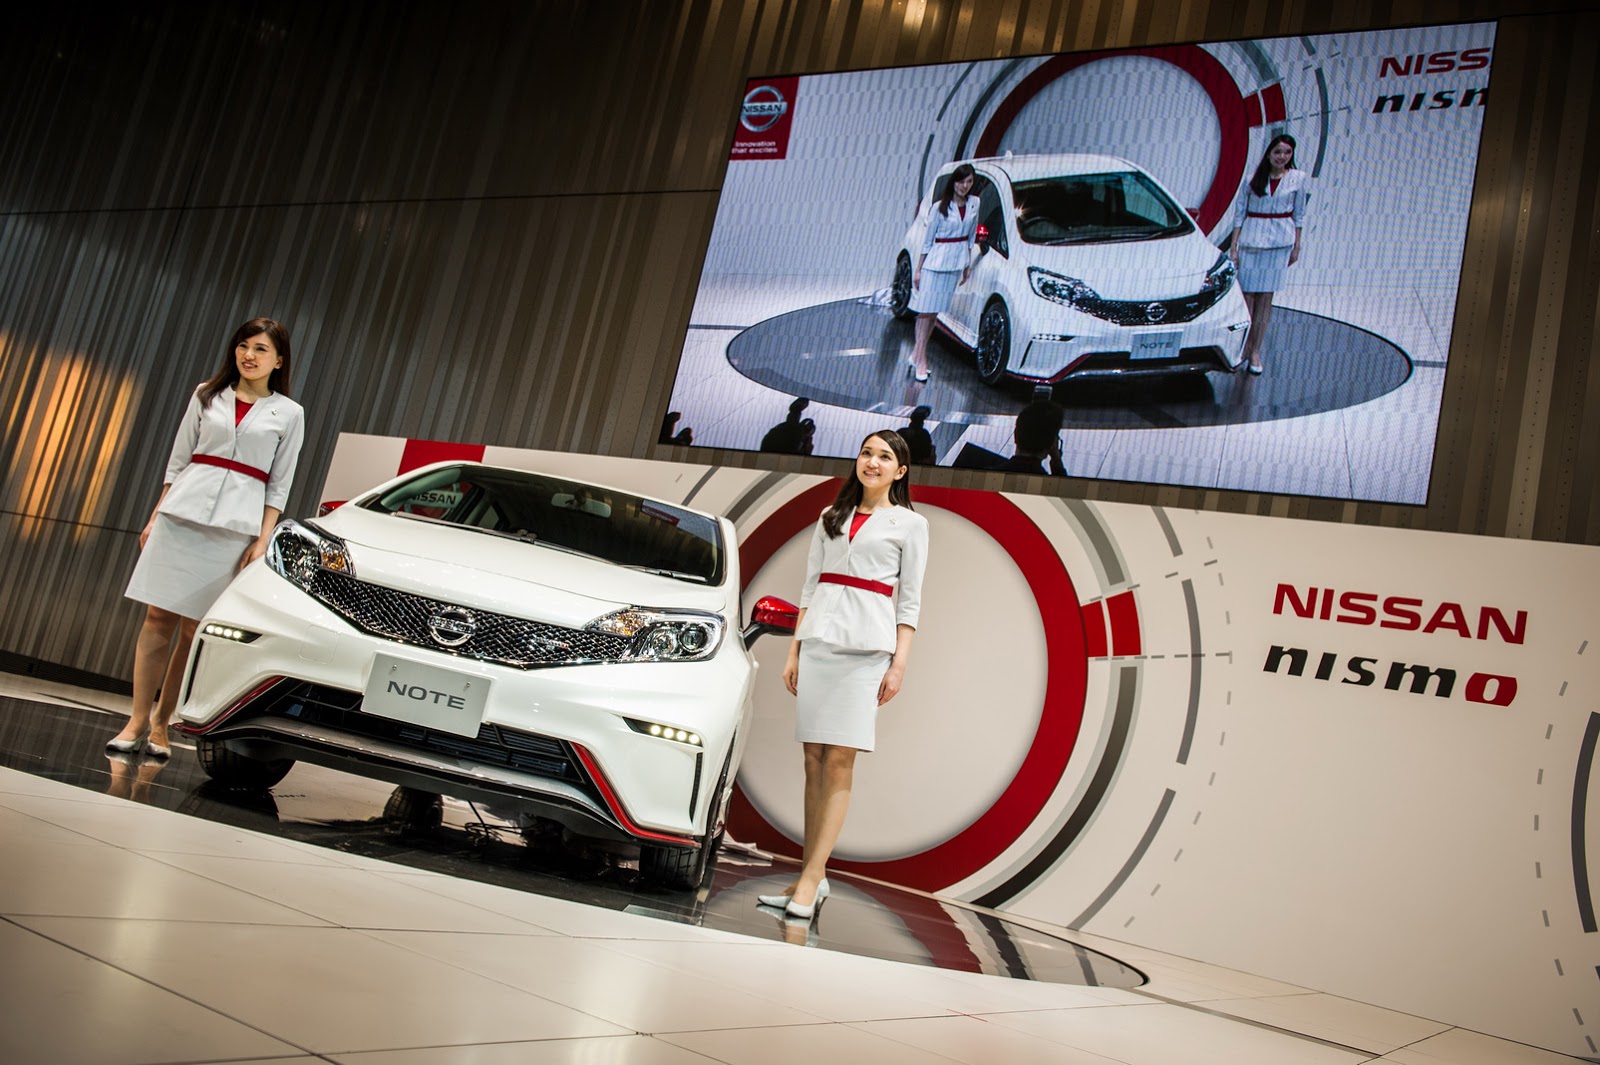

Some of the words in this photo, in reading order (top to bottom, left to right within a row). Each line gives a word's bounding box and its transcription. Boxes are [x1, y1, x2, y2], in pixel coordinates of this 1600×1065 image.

[1379, 47, 1491, 78] NISS
[741, 104, 782, 113] NISSAN
[1140, 341, 1174, 350] NOTE
[1272, 583, 1528, 645] NISSAN
[1262, 645, 1518, 707] nismo
[387, 680, 467, 710] NOTE
